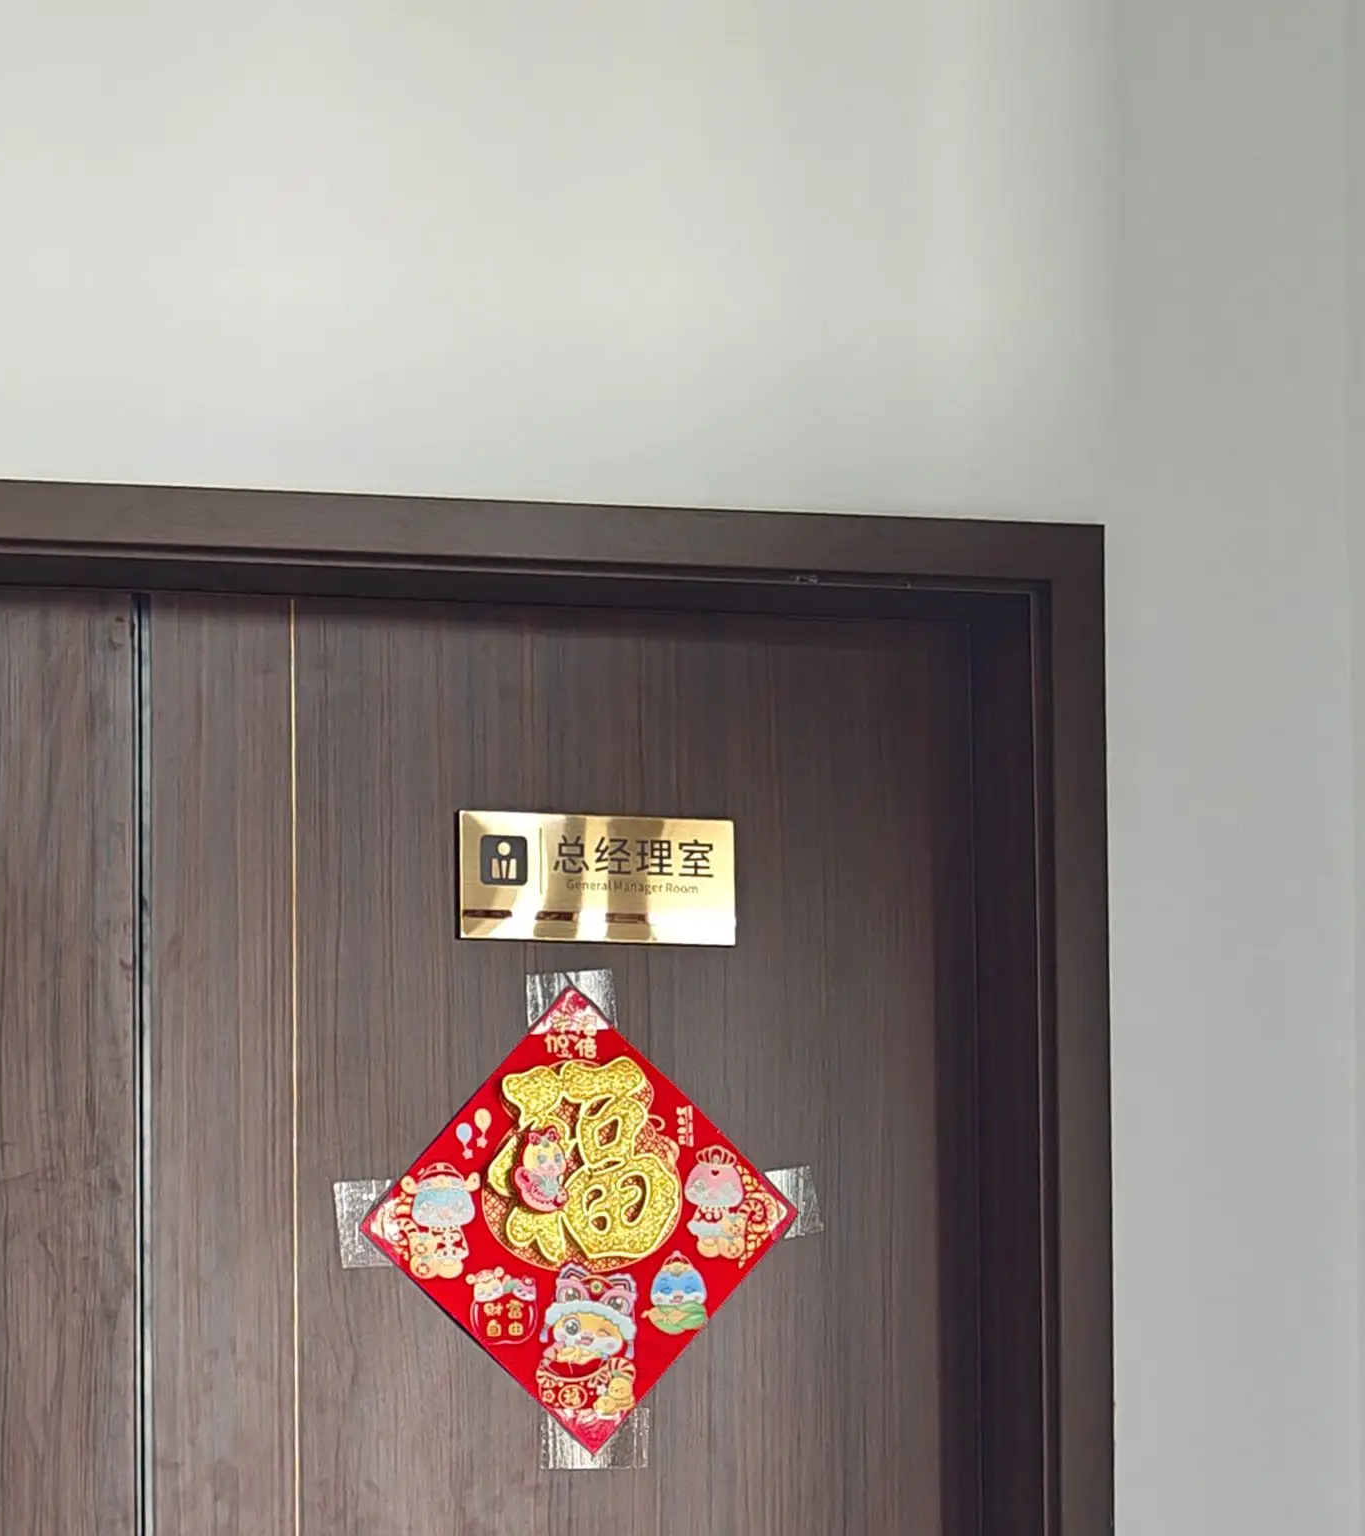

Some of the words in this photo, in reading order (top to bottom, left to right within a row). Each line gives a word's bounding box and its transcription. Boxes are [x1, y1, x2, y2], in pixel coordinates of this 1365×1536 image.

[553, 835, 714, 878] 总经理室
[566, 879, 611, 891] General
[613, 880, 663, 895] Manager
[665, 883, 699, 894] Room
[544, 1034, 598, 1059] 加倍
[488, 1056, 679, 1261] 福
